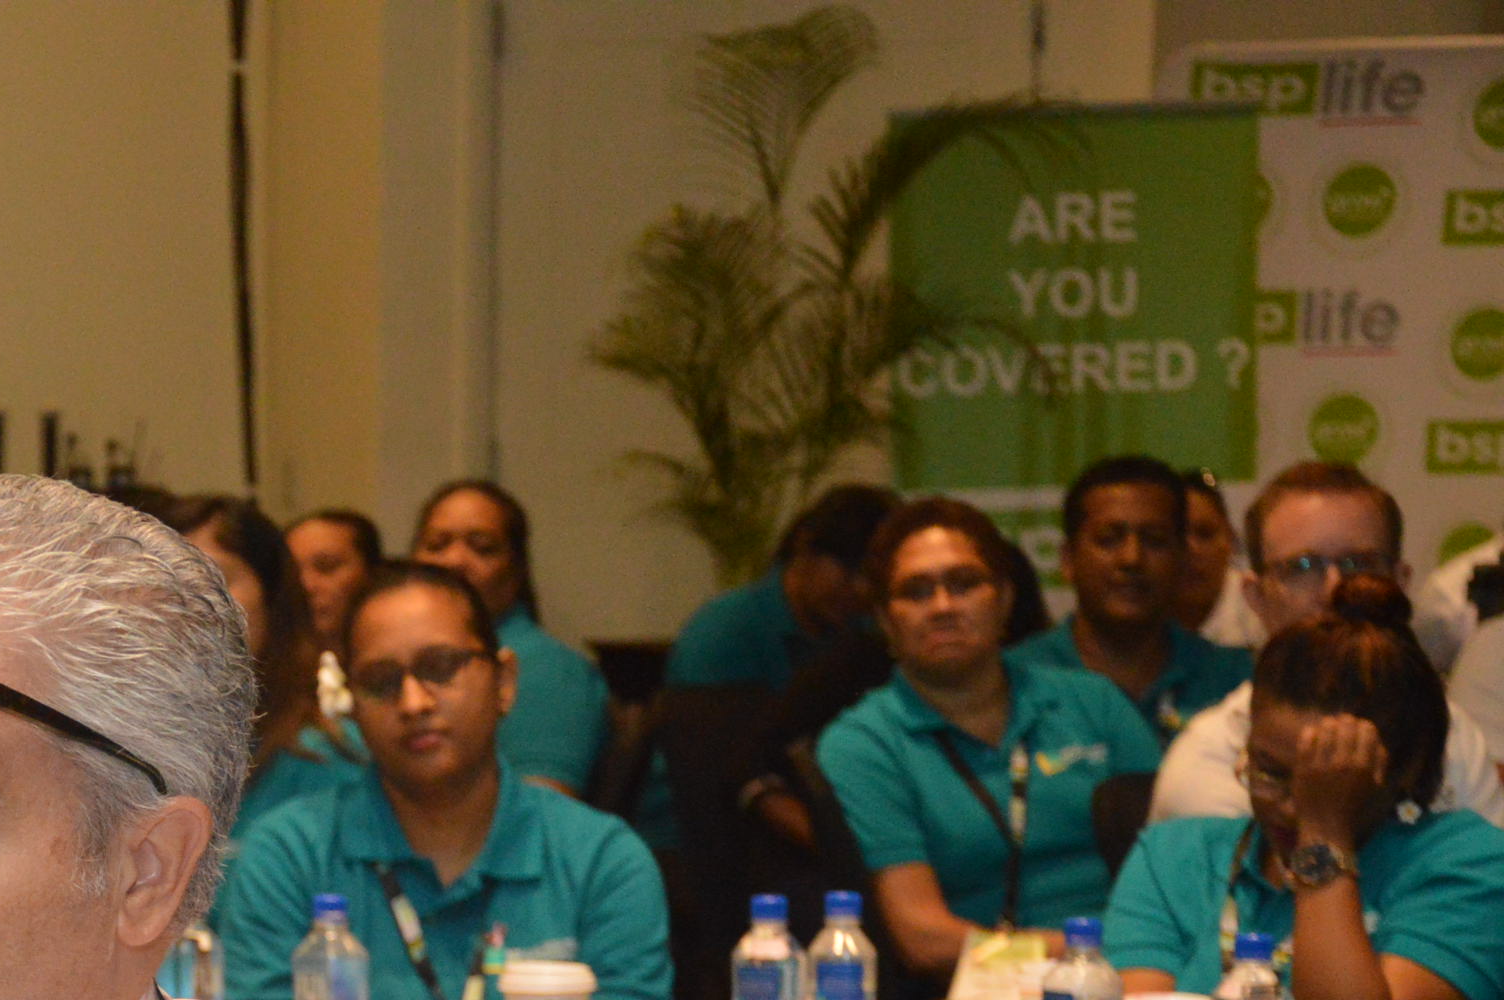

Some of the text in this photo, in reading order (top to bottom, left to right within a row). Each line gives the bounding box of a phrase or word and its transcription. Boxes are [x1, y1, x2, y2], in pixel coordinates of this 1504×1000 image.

[1200, 67, 1307, 112] bsp
[1323, 56, 1426, 115] life
[1008, 191, 1138, 245] ARE
[1008, 266, 1139, 318] YOU
[1302, 287, 1401, 344] life
[898, 338, 1198, 398] COVERED
